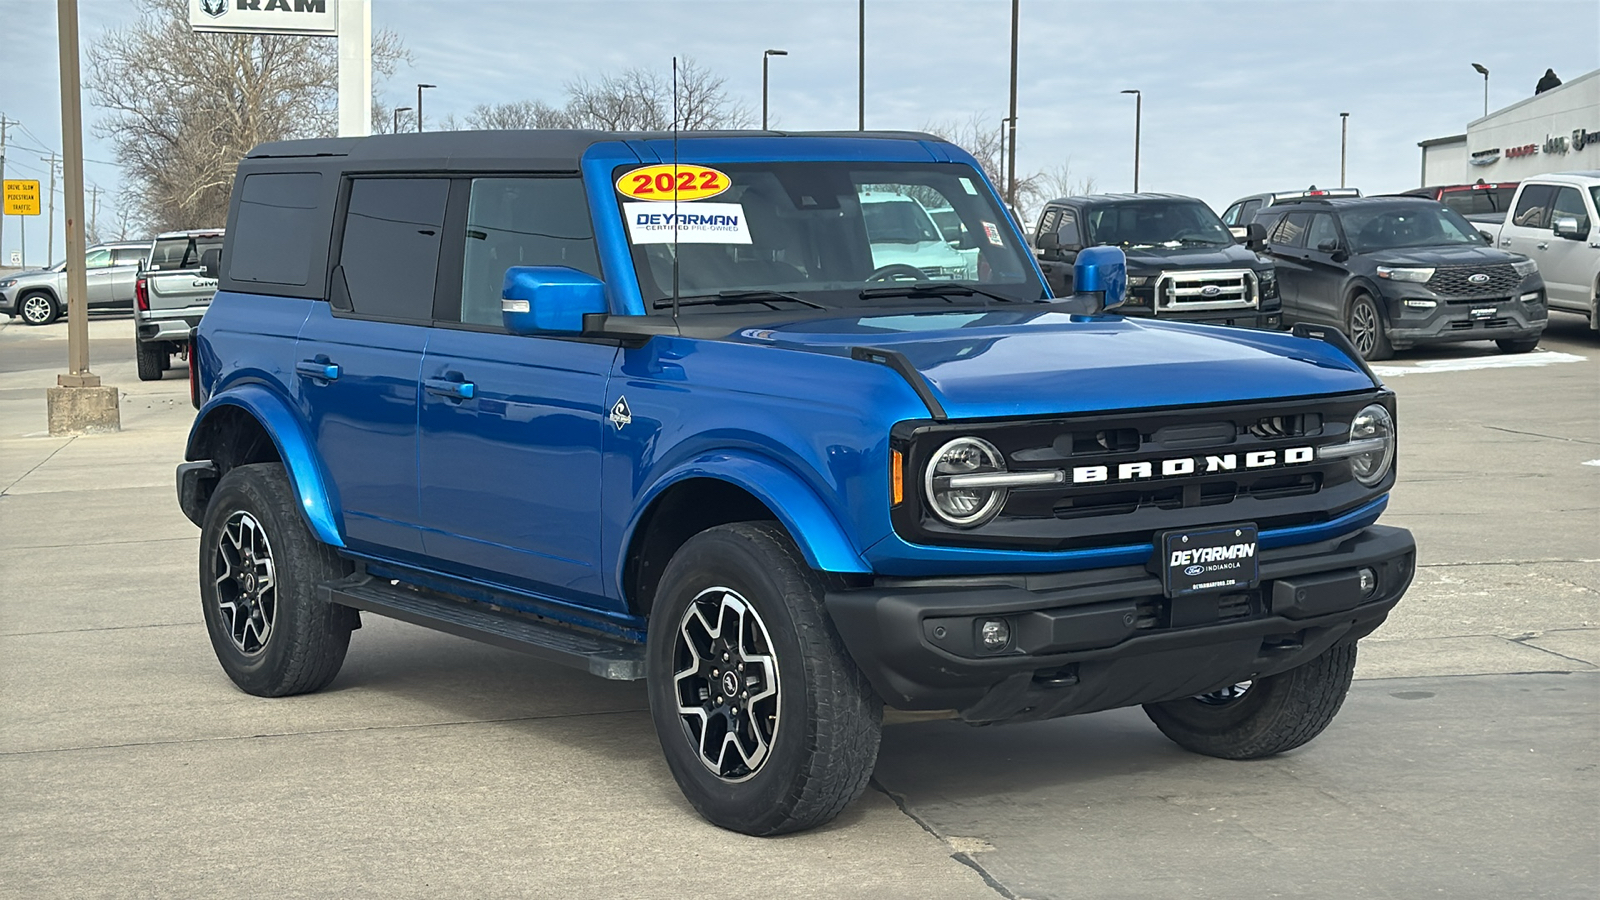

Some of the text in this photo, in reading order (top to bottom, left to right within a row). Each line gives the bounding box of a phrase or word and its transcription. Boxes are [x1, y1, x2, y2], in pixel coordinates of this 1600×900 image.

[237, 0, 326, 13] RAM
[632, 171, 720, 194] 2022
[636, 213, 739, 226] DEYARMAN
[1072, 446, 1314, 483] BRONCO
[1170, 542, 1256, 567] DEYARMAN
[1205, 562, 1241, 572] INDIANOLA
